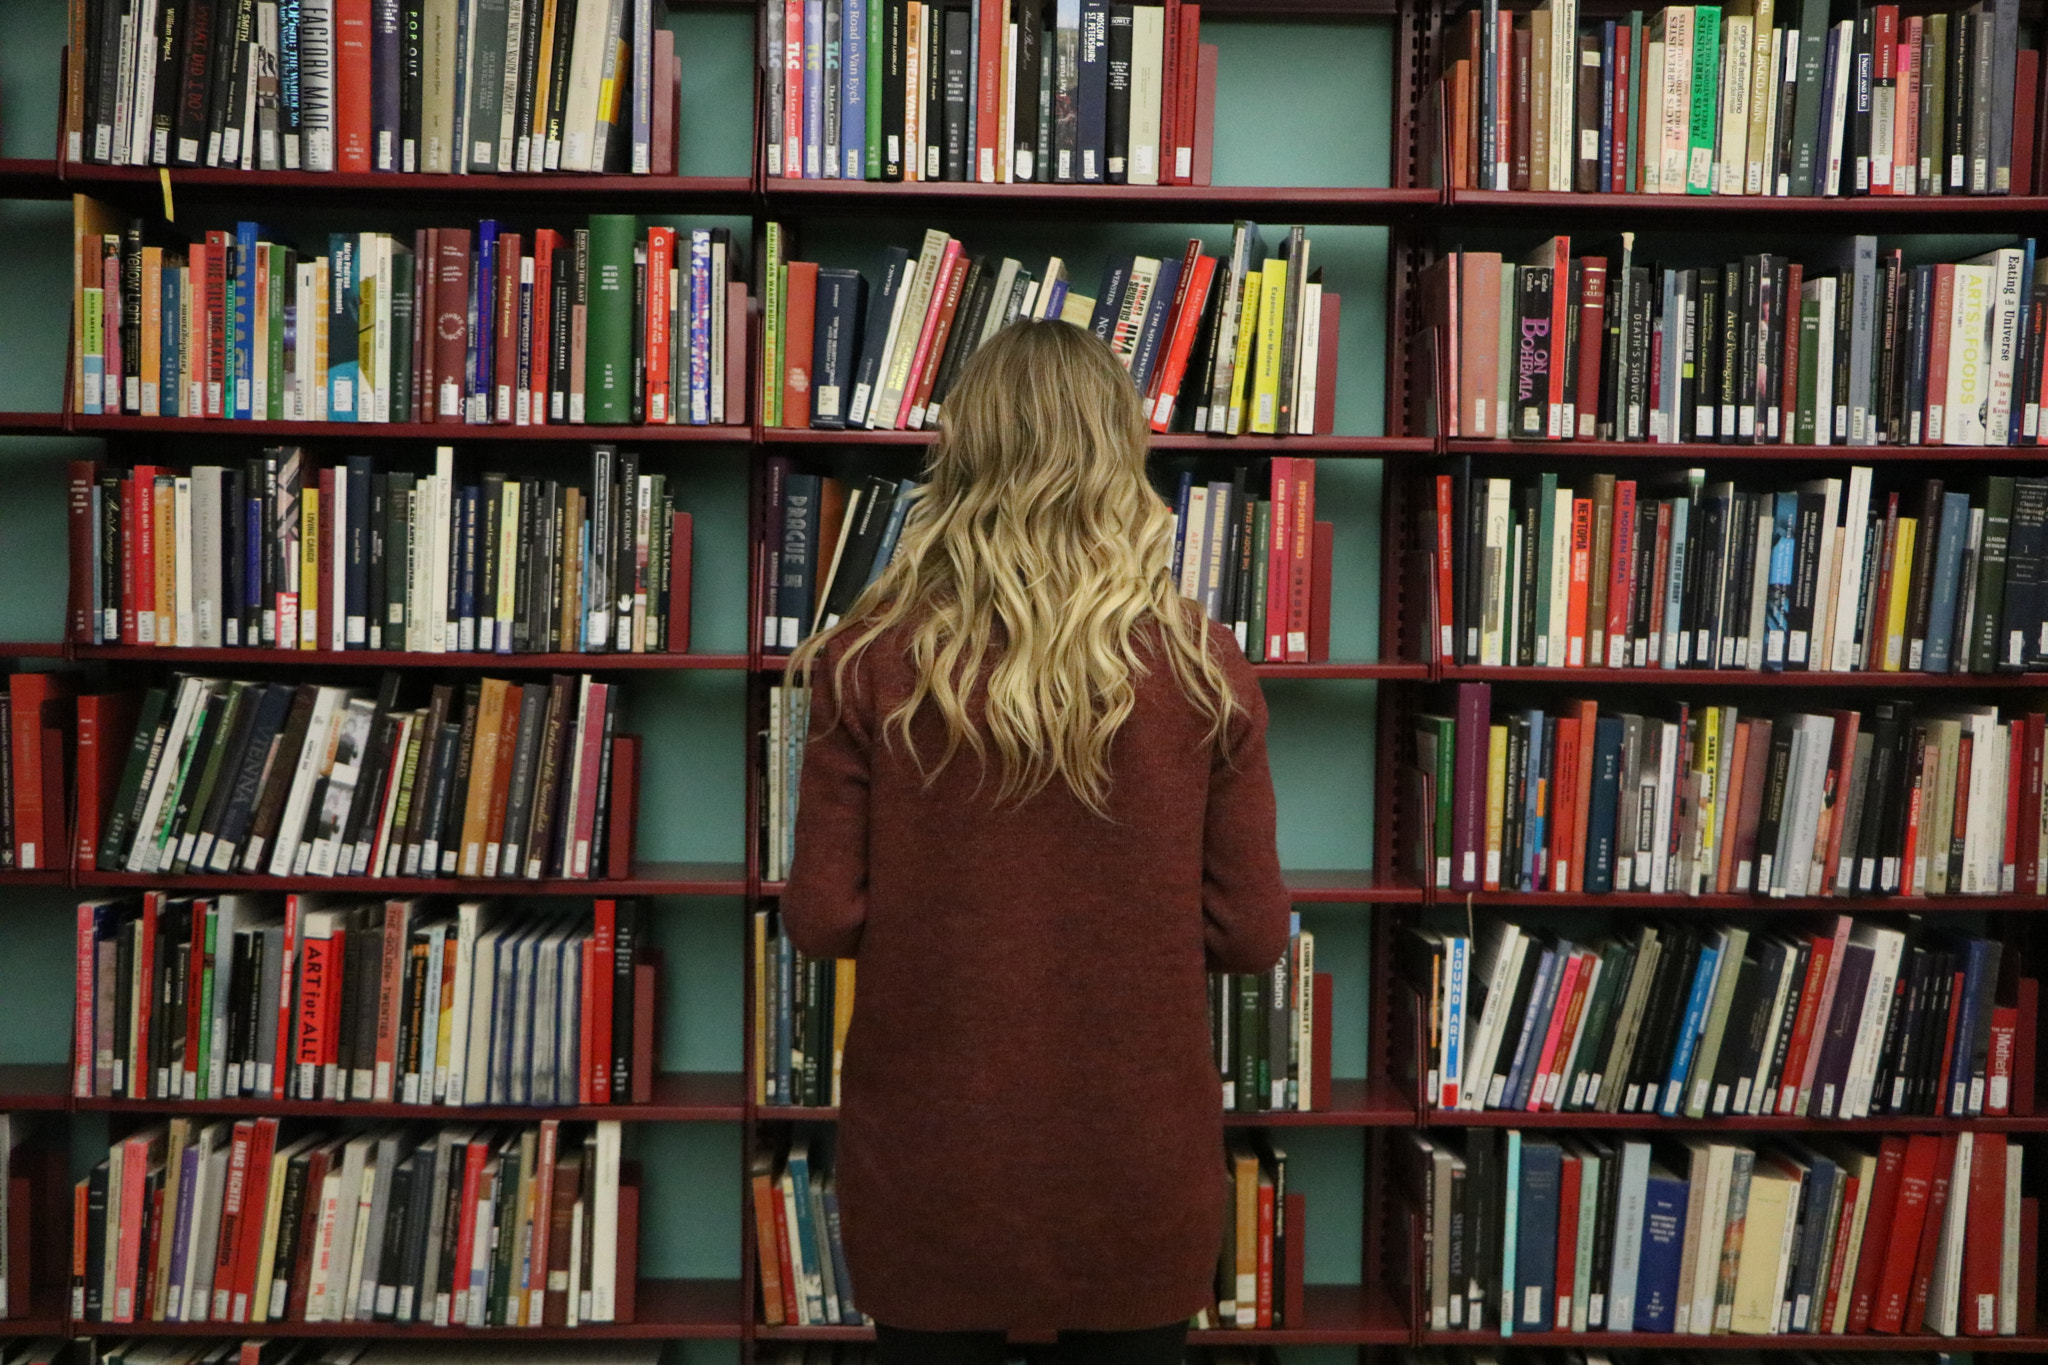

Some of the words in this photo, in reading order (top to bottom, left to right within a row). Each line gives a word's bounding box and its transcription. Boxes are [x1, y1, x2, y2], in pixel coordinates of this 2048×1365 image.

[409, 12, 418, 40] POP
[850, 11, 860, 39] Road
[1096, 13, 1105, 40] MOSCOW
[1739, 25, 1749, 49] origini
[302, 8, 329, 79] FACTORY
[769, 40, 781, 68] TLC
[788, 42, 800, 70] TLC
[808, 43, 820, 70] TLC
[826, 42, 839, 69] TLC
[850, 42, 858, 51] to
[1087, 23, 1096, 63] PETERSBURG
[409, 47, 418, 78] OUT
[850, 53, 859, 75] Van
[908, 59, 917, 91] REAL
[847, 78, 860, 104] Eyck
[907, 95, 916, 119] VAN
[906, 123, 916, 143] GO
[1880, 119, 1888, 156] Economic
[127, 251, 141, 289] Yellow
[2002, 255, 2020, 295] Eating
[522, 292, 531, 316] BOTH
[1939, 276, 1950, 307] VENUS
[127, 294, 141, 324] Light
[1726, 310, 1737, 328] Art
[1726, 331, 1736, 340] &
[2001, 310, 2015, 361] Universe
[210, 337, 222, 382] MACHI
[1518, 316, 1549, 402] BOHEMIA
[1533, 349, 1548, 375] ON
[1722, 342, 1736, 403] Pornography
[1630, 362, 1640, 406] SHOWCA
[624, 463, 634, 506] DOUGLAS
[623, 509, 632, 551] GORDON
[784, 495, 808, 565] PRAGUE
[1576, 502, 1589, 550] NEWTOPIA
[1190, 532, 1200, 550] ART
[1186, 571, 1197, 599] TURM
[1777, 751, 1787, 780] SIGHT
[306, 946, 322, 987] ART
[1452, 948, 1463, 1005] SOUND
[304, 991, 320, 1018] for
[1449, 1013, 1459, 1046] ART
[232, 1140, 246, 1168] HANS
